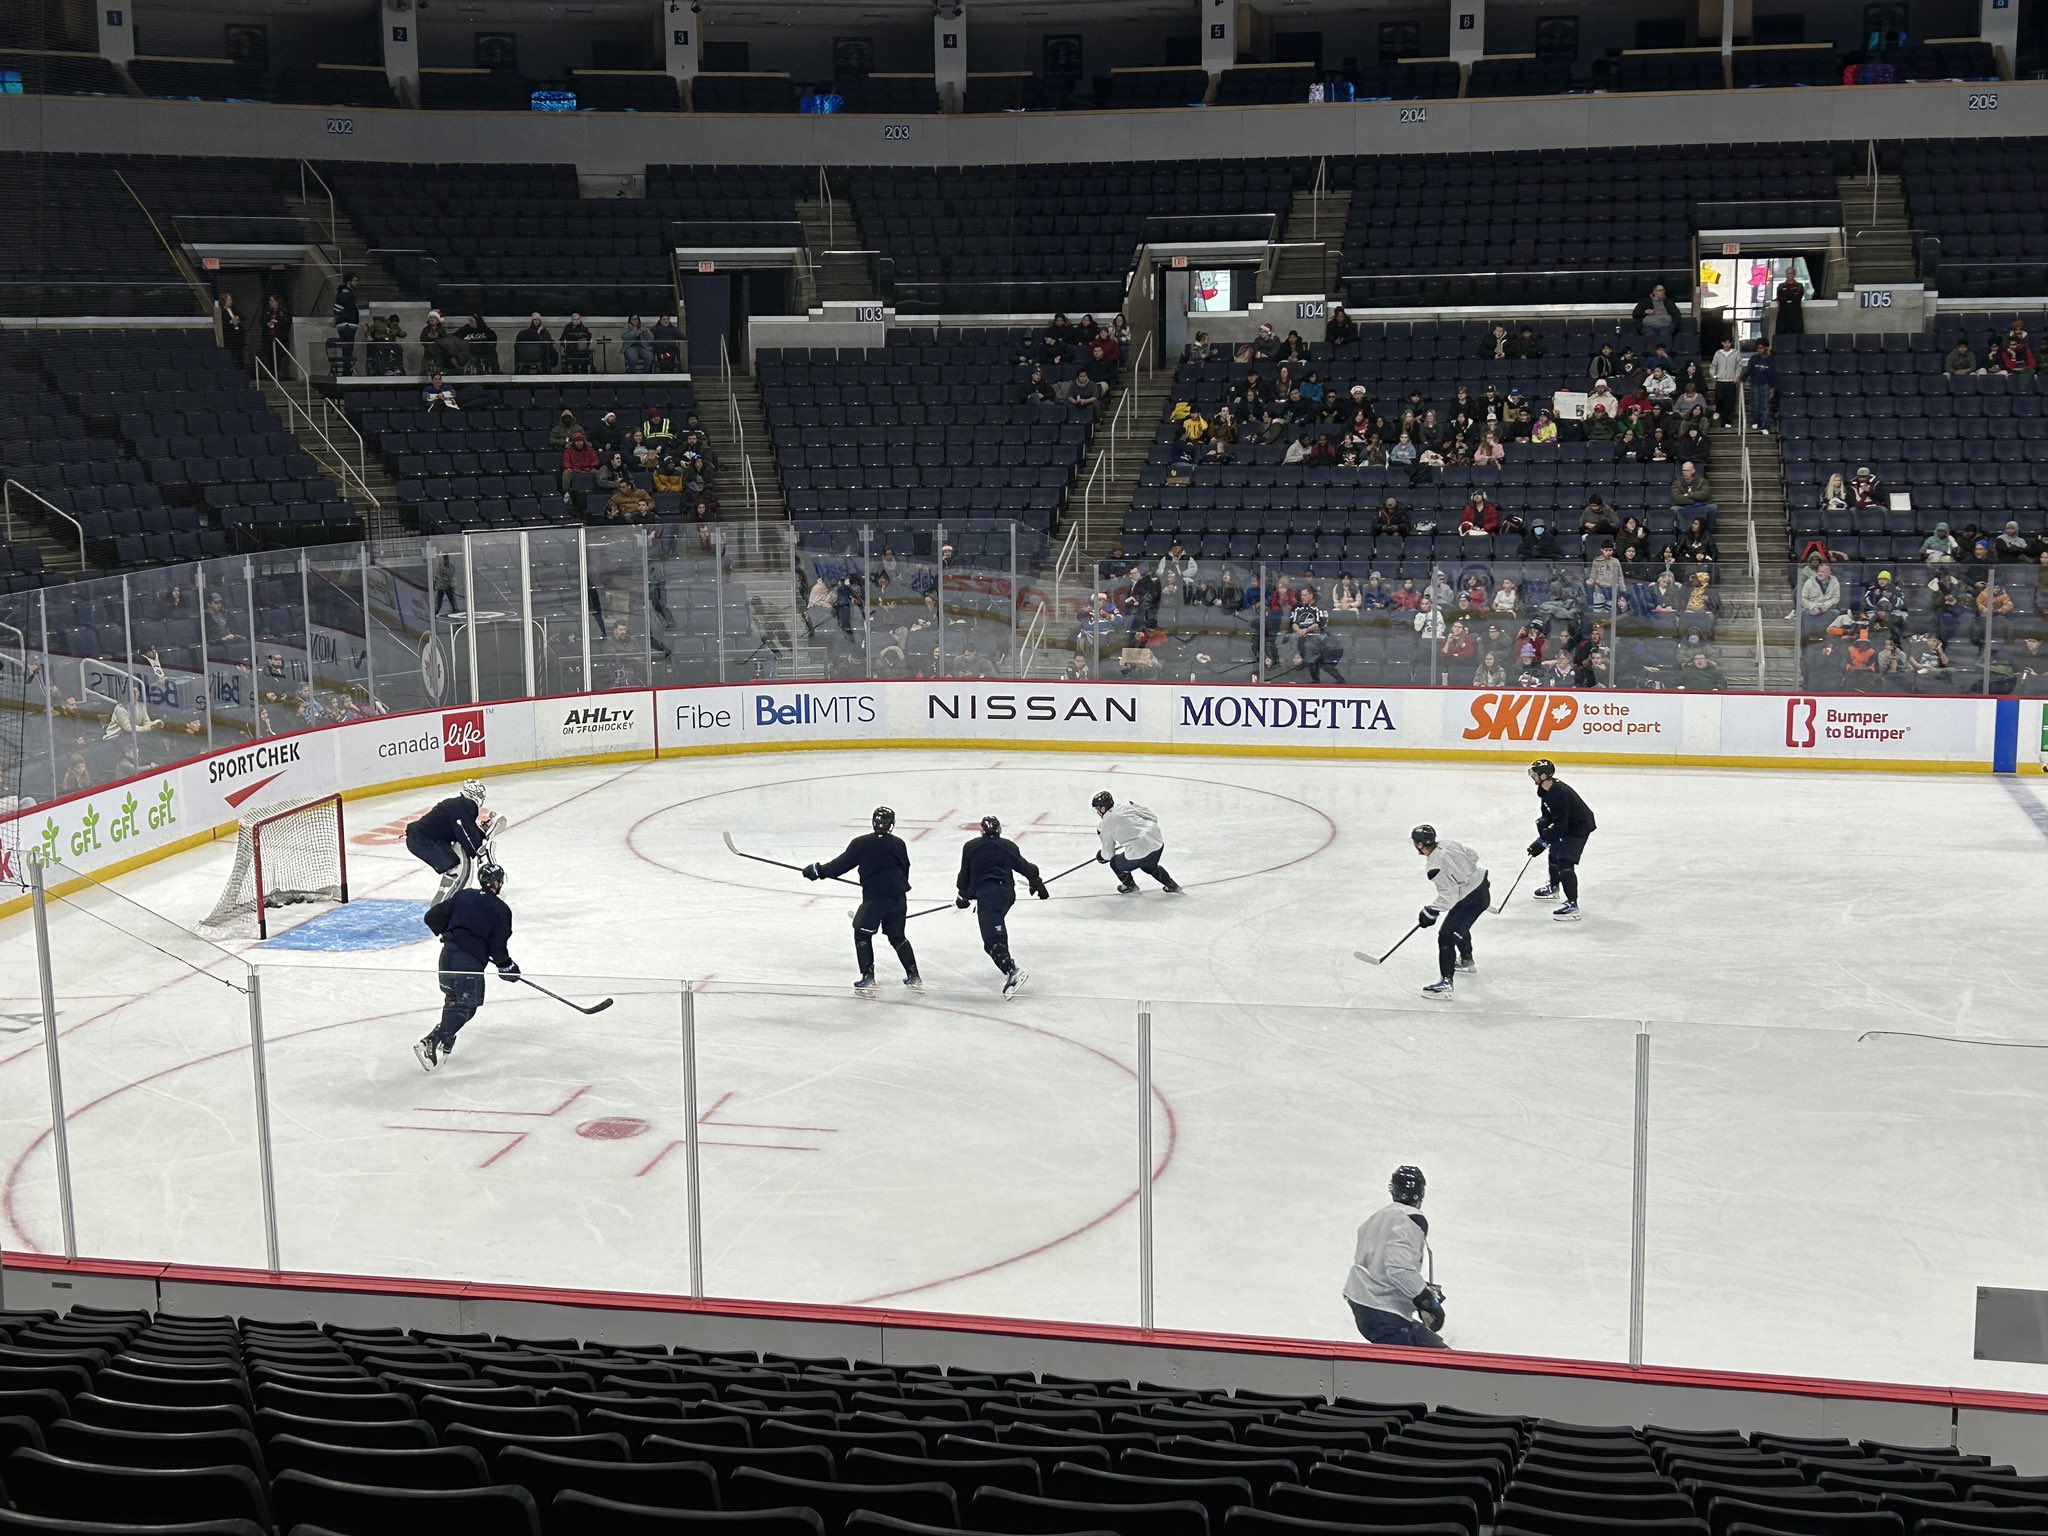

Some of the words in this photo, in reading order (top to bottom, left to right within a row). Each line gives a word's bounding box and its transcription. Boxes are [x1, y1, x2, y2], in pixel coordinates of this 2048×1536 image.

[1214, 27, 1221, 37] 5
[1969, 94, 1997, 109] 205
[1400, 108, 1427, 123] 204
[327, 119, 353, 134] 202
[884, 126, 909, 140] 203
[1862, 292, 1892, 308] 105
[858, 307, 882, 321] 103
[1298, 303, 1324, 318] 104
[928, 694, 1137, 722] NISSAN
[1179, 696, 1396, 731] MONDETTA
[1583, 703, 1600, 716] to
[1602, 702, 1630, 716] the
[676, 704, 731, 730] Fibe
[1462, 693, 1579, 741] SKIP
[1826, 709, 1889, 727] Bumper
[562, 726, 574, 735] ON
[1582, 719, 1623, 735] good
[1627, 721, 1661, 736] part
[1825, 725, 1841, 739] to
[1844, 725, 1906, 742] Bumper
[378, 731, 440, 759] canada
[443, 720, 486, 755] life
[208, 741, 301, 784] SPORTCHEK
[71, 814, 102, 856] GFL
[110, 801, 140, 843] GFL
[148, 789, 176, 830] GFL
